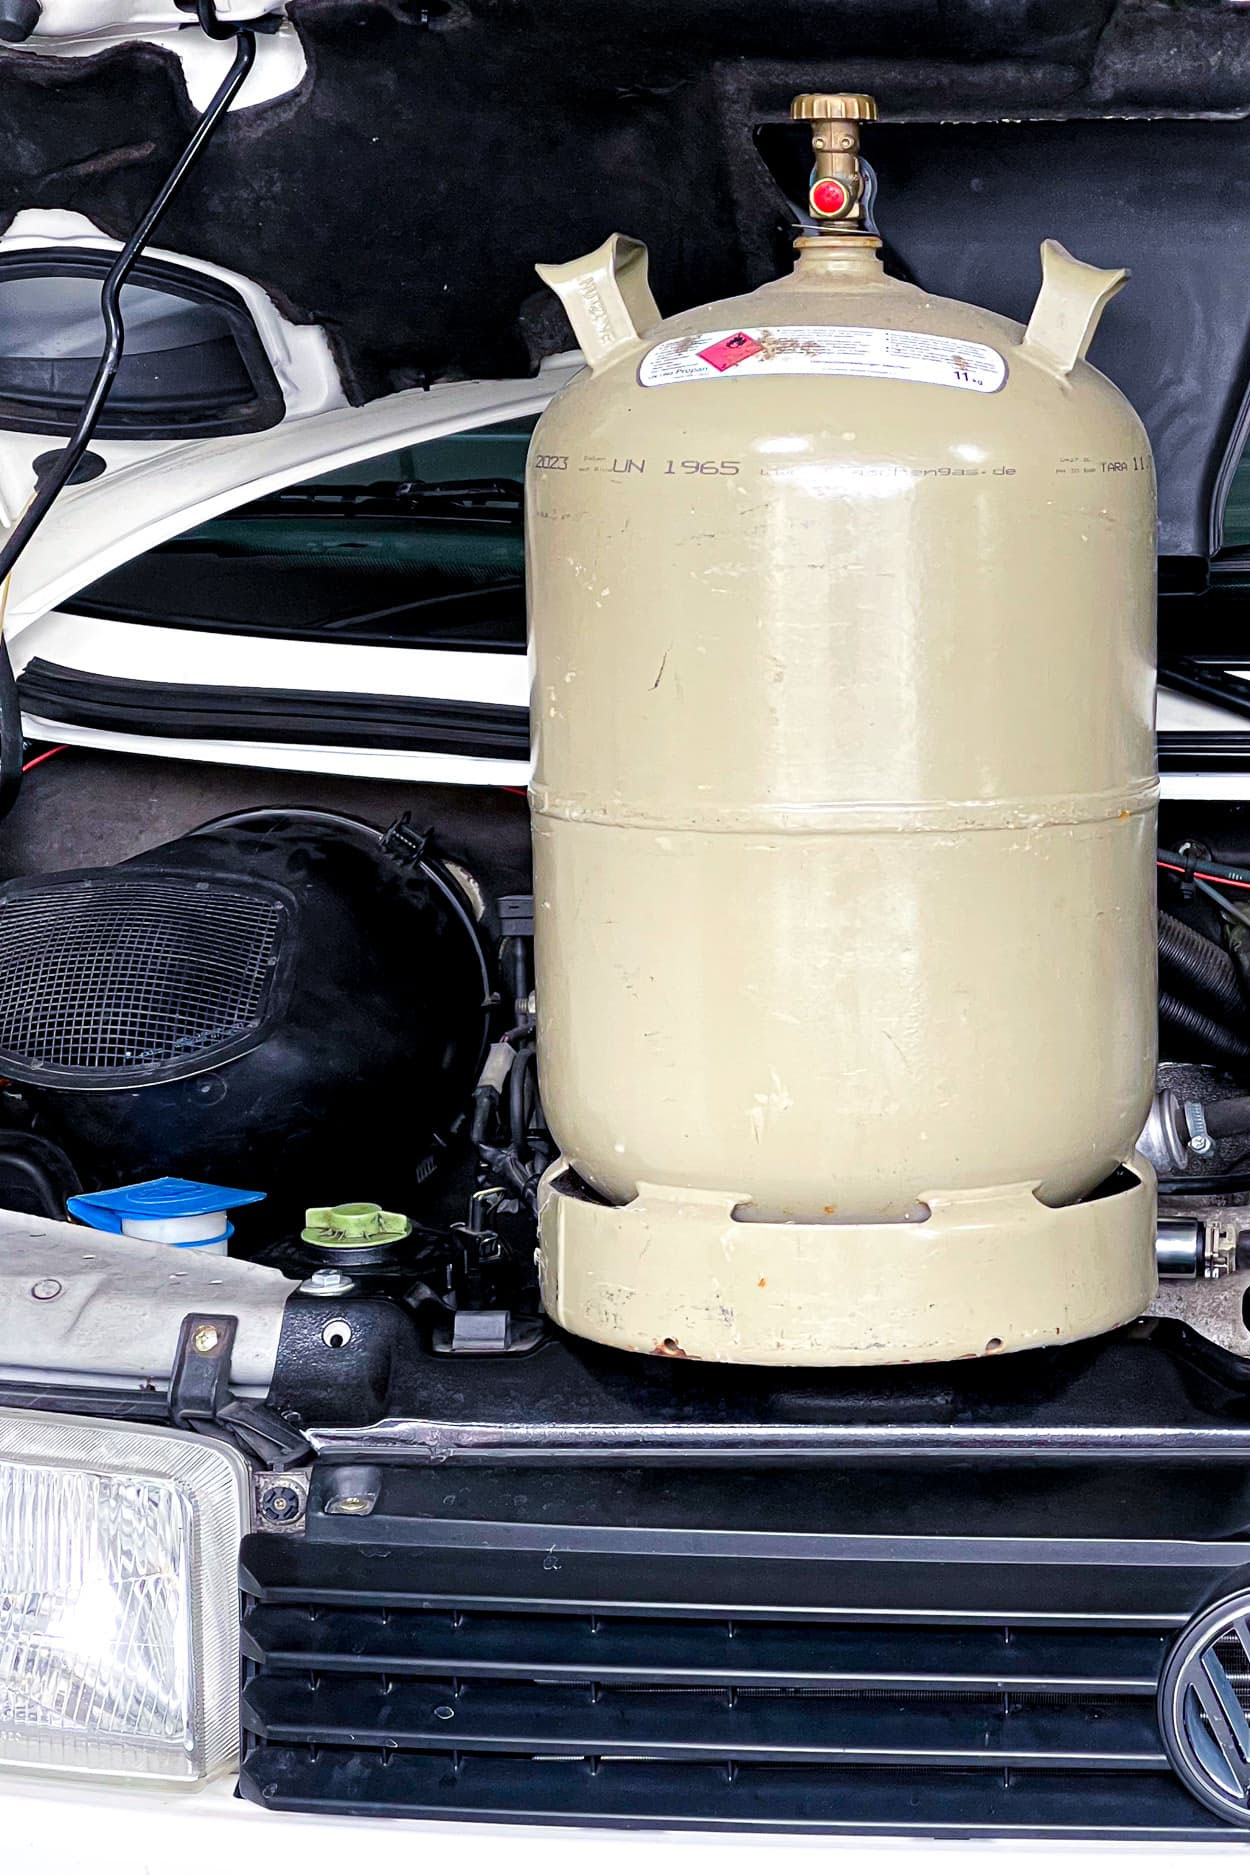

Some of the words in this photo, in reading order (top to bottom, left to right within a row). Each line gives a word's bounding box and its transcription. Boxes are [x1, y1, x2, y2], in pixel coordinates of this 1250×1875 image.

[953, 371, 969, 382] 11
[535, 454, 569, 471] 2023
[612, 459, 646, 474] UN
[664, 460, 742, 476] 1965
[1101, 461, 1128, 473] TARA
